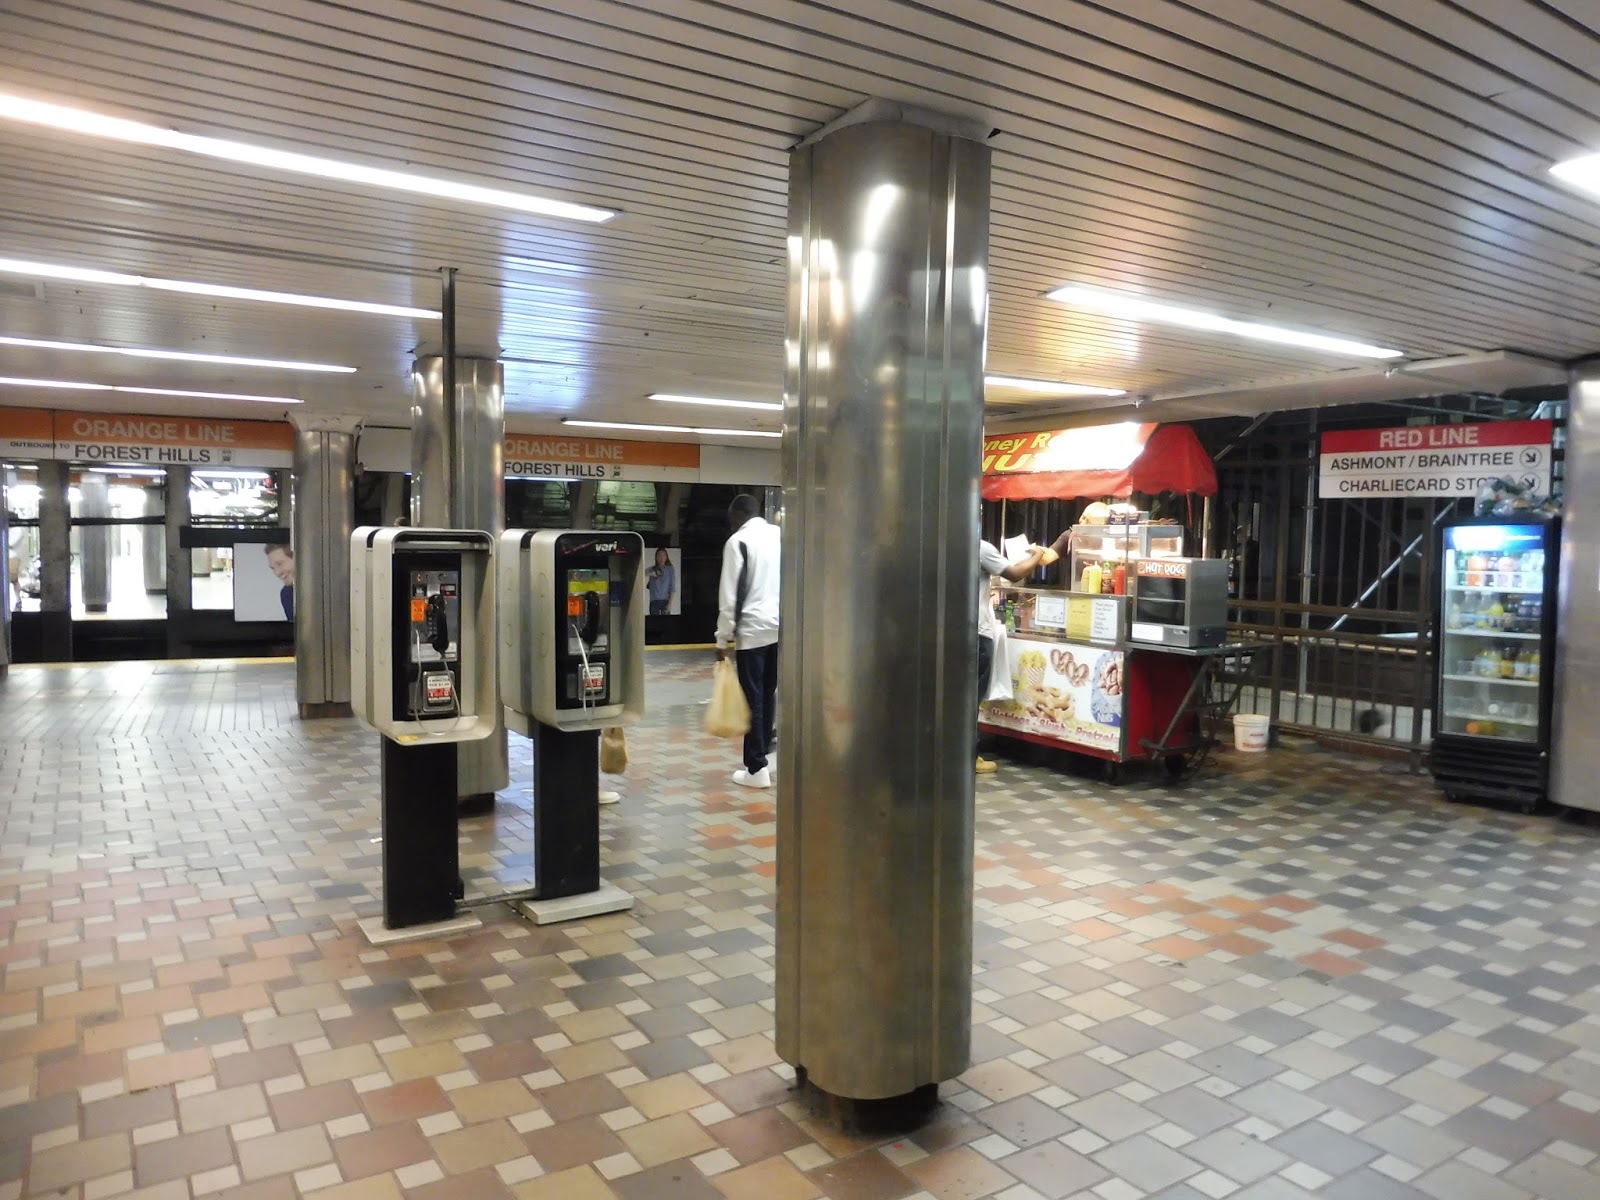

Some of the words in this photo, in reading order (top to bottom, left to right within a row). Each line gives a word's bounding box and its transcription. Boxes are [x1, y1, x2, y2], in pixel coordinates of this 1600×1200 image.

[73, 419, 177, 439] ORANGE
[184, 423, 236, 442] LINE
[1379, 430, 1423, 448] RED
[1428, 426, 1479, 445] LINE
[74, 444, 154, 461] FOREST
[158, 447, 211, 462] HILLS
[504, 440, 579, 457] ORANGE
[585, 444, 623, 460] LINE
[504, 461, 561, 476] FOREST
[565, 464, 606, 477] HILLS
[1331, 455, 1406, 471] ASHMONT
[1418, 451, 1514, 467] BRAINTREE
[1339, 477, 1451, 492] CHARLIECARD
[1145, 562, 1163, 574] HOT
[1164, 564, 1185, 575] DOGS
[1039, 719, 1066, 732] Slush
